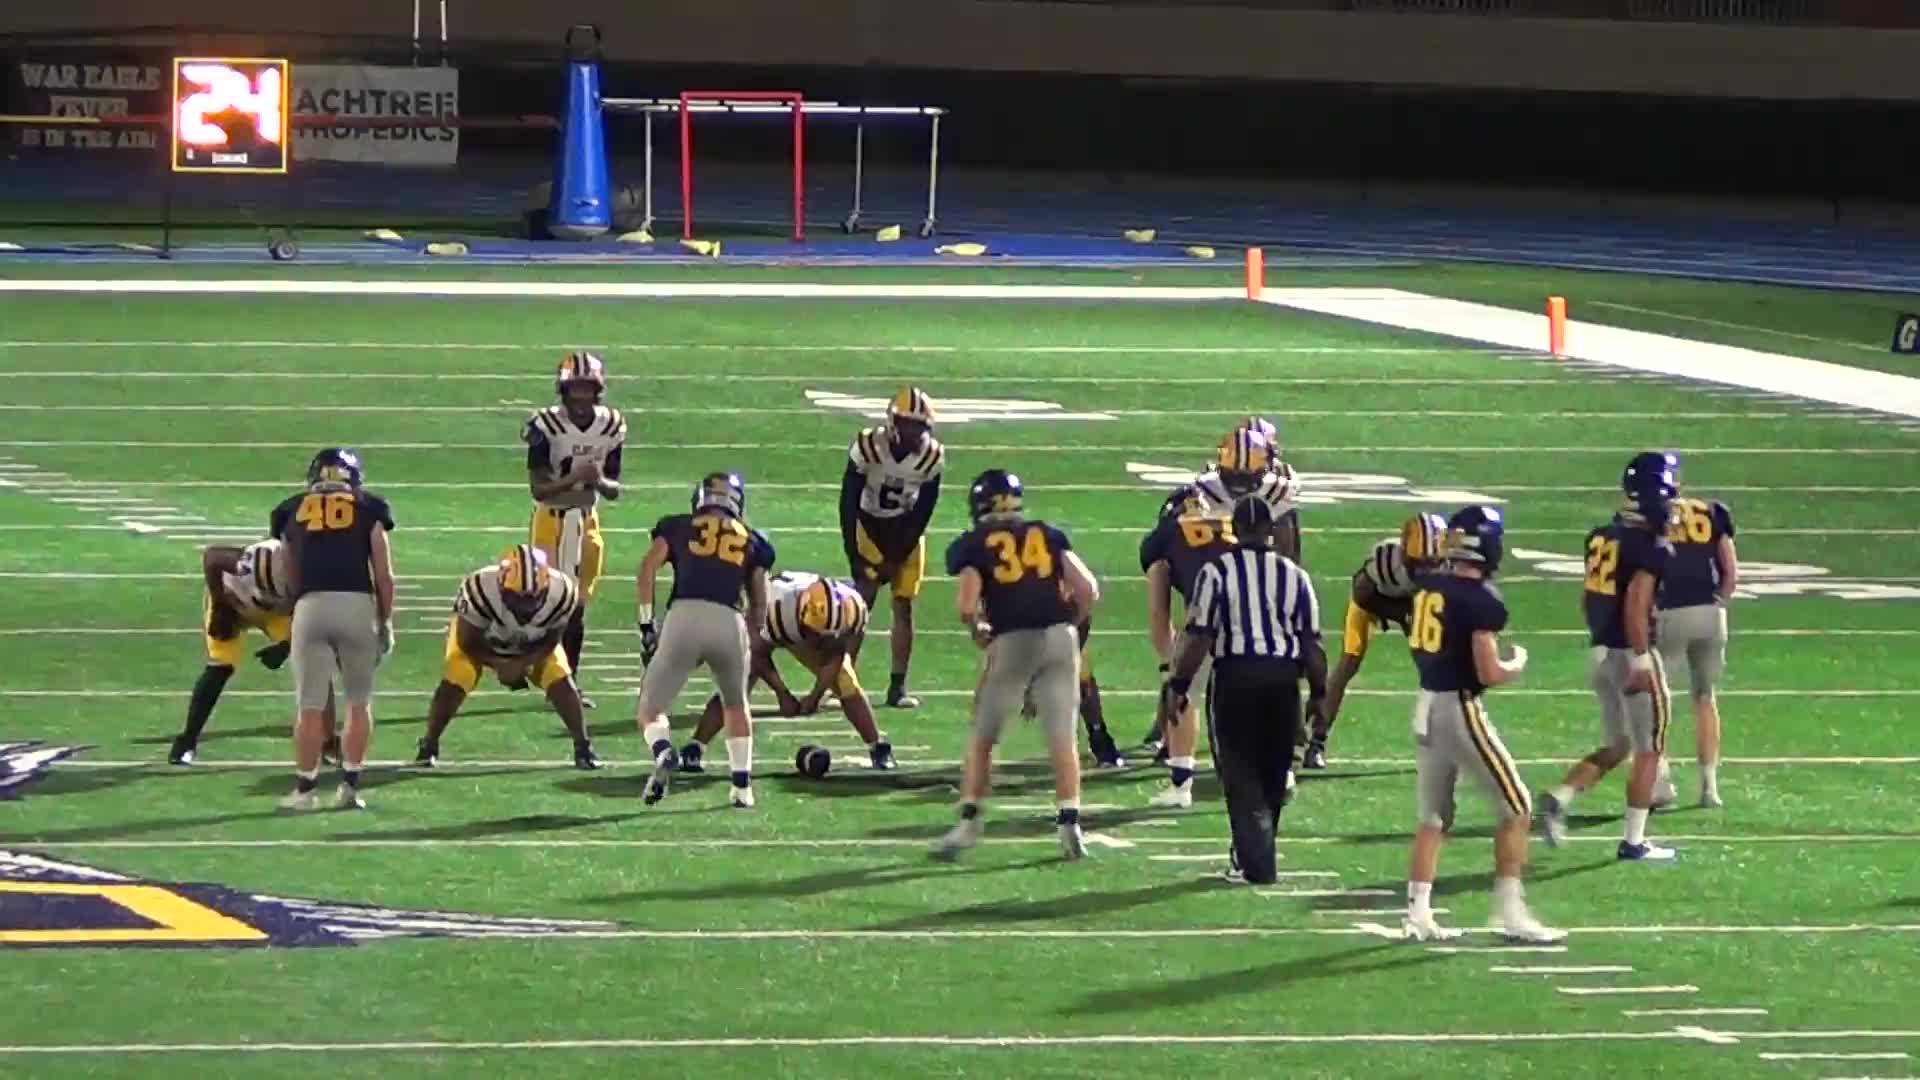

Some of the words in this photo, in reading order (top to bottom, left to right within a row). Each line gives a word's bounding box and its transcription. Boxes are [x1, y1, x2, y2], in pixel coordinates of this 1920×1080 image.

[20, 63, 78, 88] WAR
[180, 64, 281, 144] 24
[1898, 319, 1918, 350] G
[296, 491, 355, 530] 46
[689, 515, 748, 567] 32
[985, 527, 1052, 582] 34
[1584, 535, 1619, 596] 22
[1408, 589, 1445, 653] 16
